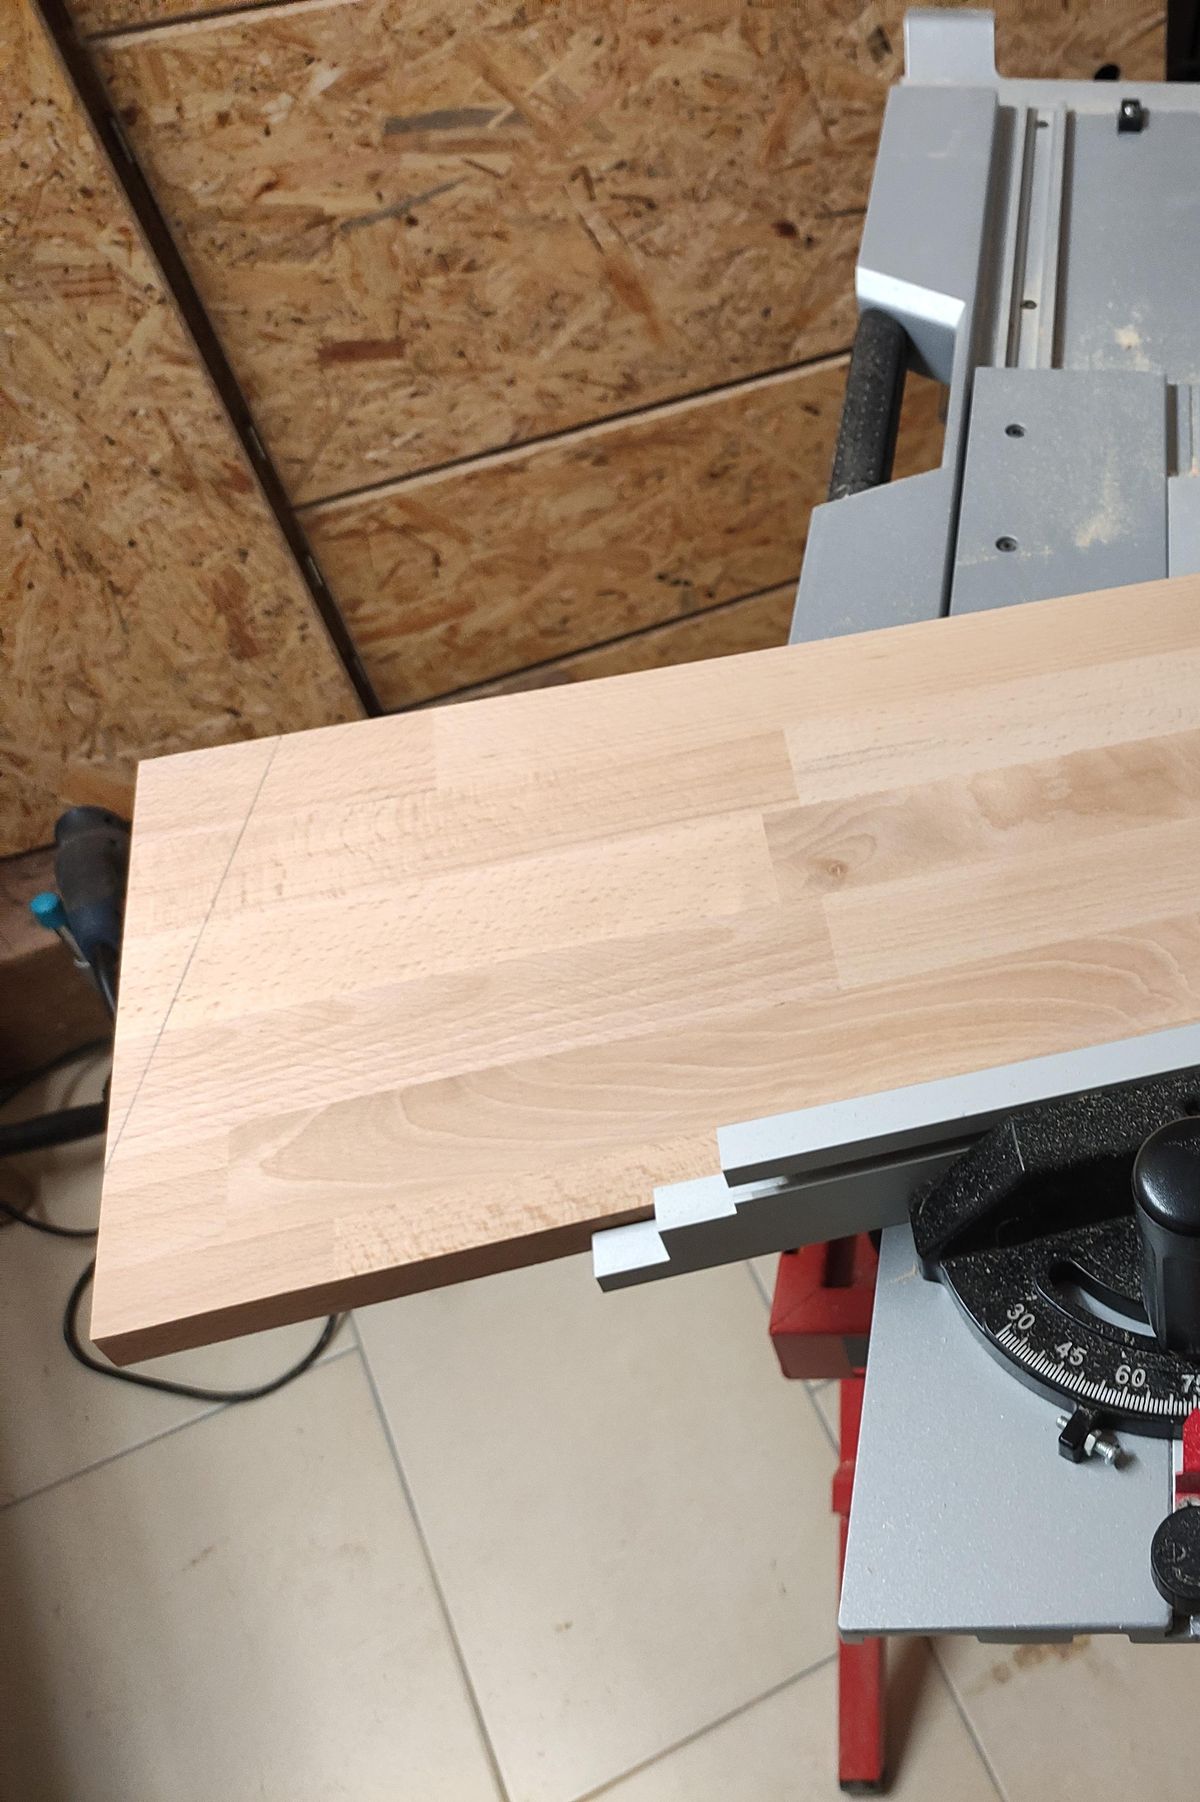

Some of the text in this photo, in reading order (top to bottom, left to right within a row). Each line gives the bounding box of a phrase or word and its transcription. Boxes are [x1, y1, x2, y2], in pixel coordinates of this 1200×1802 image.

[1006, 1303, 1036, 1330] 30
[1055, 1341, 1087, 1366] 45
[1115, 1365, 1146, 1388] 60
